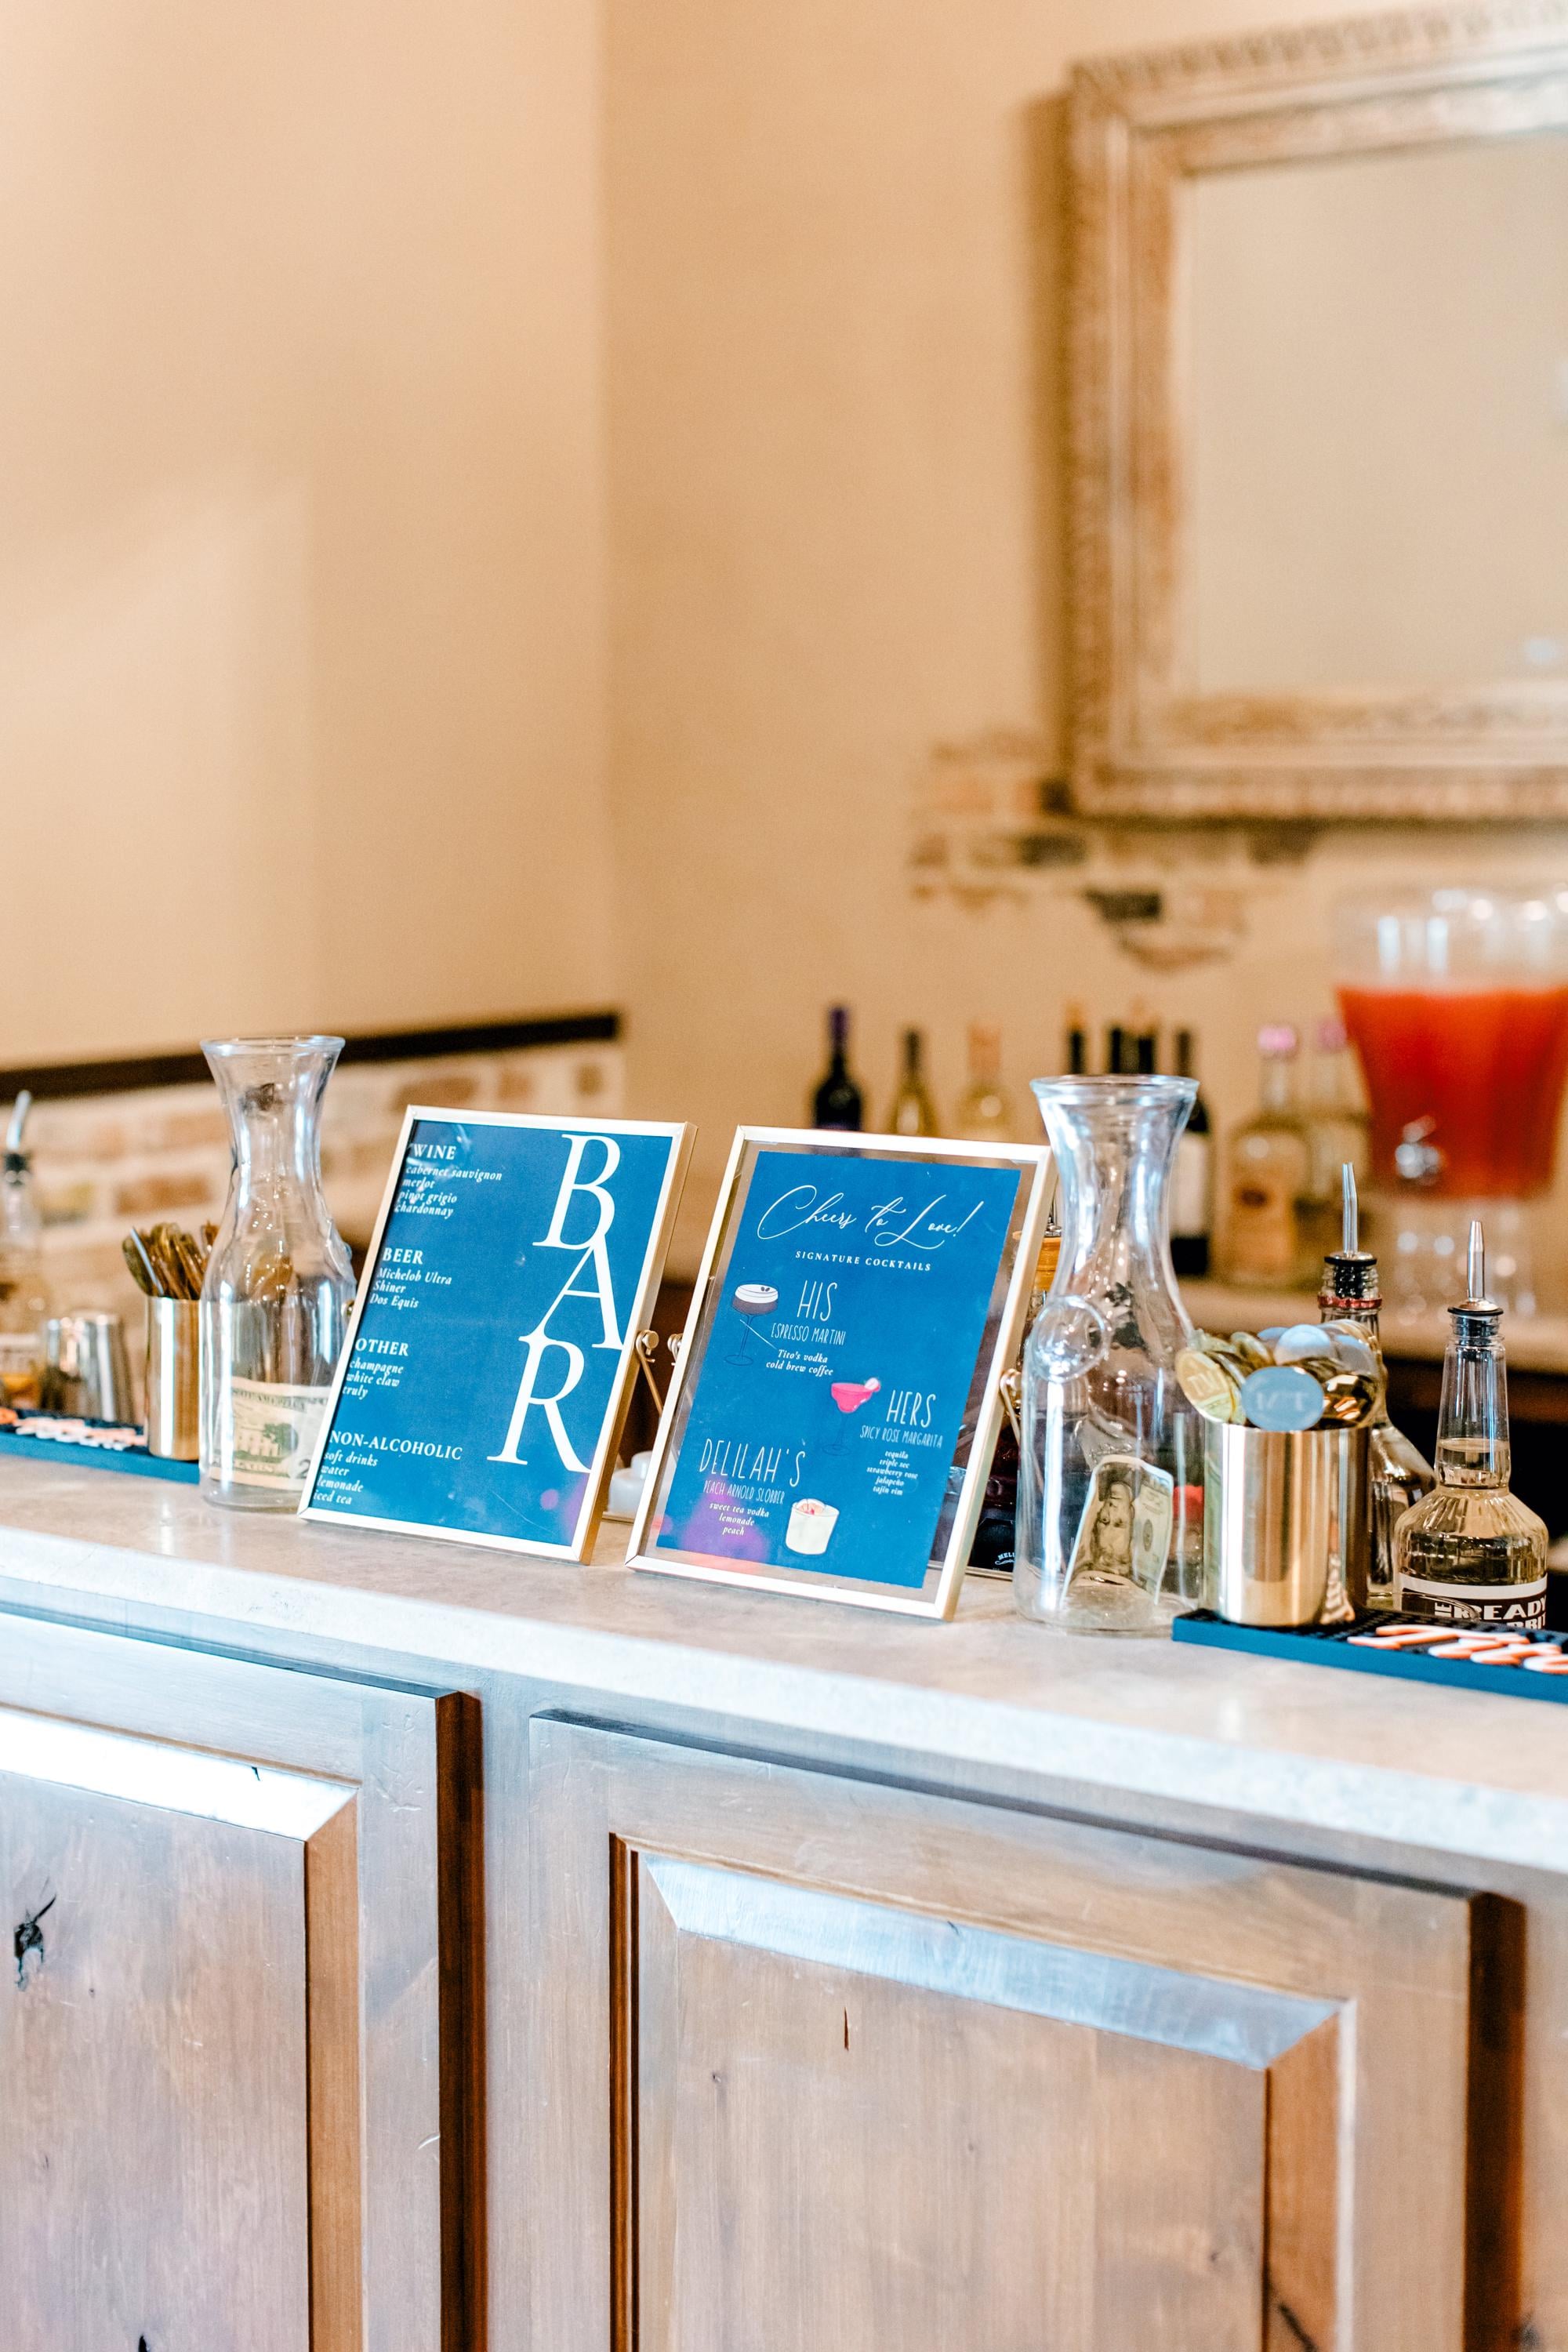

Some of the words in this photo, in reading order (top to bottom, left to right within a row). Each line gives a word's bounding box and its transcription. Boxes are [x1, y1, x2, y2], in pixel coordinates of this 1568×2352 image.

[411, 1143, 457, 1160] WINE
[405, 1163, 448, 1177] cabernet
[451, 1169, 503, 1182] sauvignon
[401, 1177, 436, 1189] merlot
[397, 1190, 425, 1203] pinot
[426, 1192, 458, 1206] grigio
[394, 1201, 454, 1219] chardonnay
[757, 1185, 857, 1240] Cheers
[865, 1196, 906, 1233] to
[874, 1194, 985, 1250] Love!
[383, 1247, 424, 1265] BEER
[795, 1250, 861, 1265] SIGNATURE
[865, 1258, 931, 1272] COCKTAILS
[376, 1267, 422, 1282] Michelob
[424, 1272, 452, 1285] Ultra
[372, 1279, 406, 1294] Shiner
[369, 1293, 389, 1305] Dos
[390, 1295, 419, 1310] Equis
[486, 1134, 624, 1474] BAR
[797, 1279, 838, 1322] HIS
[771, 1323, 810, 1342] ESPRESSO
[811, 1327, 847, 1346] MARTINI
[355, 1338, 408, 1356] OTHER
[778, 1348, 801, 1360] Tito's
[804, 1352, 828, 1363] vodka
[350, 1357, 404, 1376] champagne
[766, 1359, 785, 1370] cold
[786, 1361, 807, 1373] brew
[808, 1365, 833, 1377] coffee
[346, 1370, 374, 1384] white
[376, 1374, 401, 1387] claw
[342, 1385, 368, 1400] truly
[886, 1389, 937, 1428] HERS
[329, 1430, 463, 1461] NON-ALCOHOLIC
[859, 1425, 881, 1440] SPICY
[881, 1428, 902, 1443] ROSE
[902, 1430, 943, 1449] MARGARITA
[324, 1450, 343, 1465] soft
[345, 1452, 379, 1467] drinks
[699, 1438, 806, 1487] DELILAH'S
[879, 1458, 898, 1469] triple
[884, 1450, 909, 1460] tequila
[320, 1465, 350, 1476] water
[866, 1466, 903, 1479] strawberry
[317, 1475, 364, 1493] lemonade
[702, 1479, 726, 1495] PEACH
[726, 1483, 755, 1501] ARNOLD
[756, 1487, 786, 1504] SLOBBER
[891, 1487, 904, 1497] rim
[313, 1490, 332, 1502] iced
[336, 1494, 353, 1504] tea
[709, 1501, 731, 1512] sweet
[732, 1504, 745, 1514] tea
[746, 1507, 770, 1518] vodka
[719, 1512, 755, 1526] lemonade
[722, 1526, 745, 1537] peach
